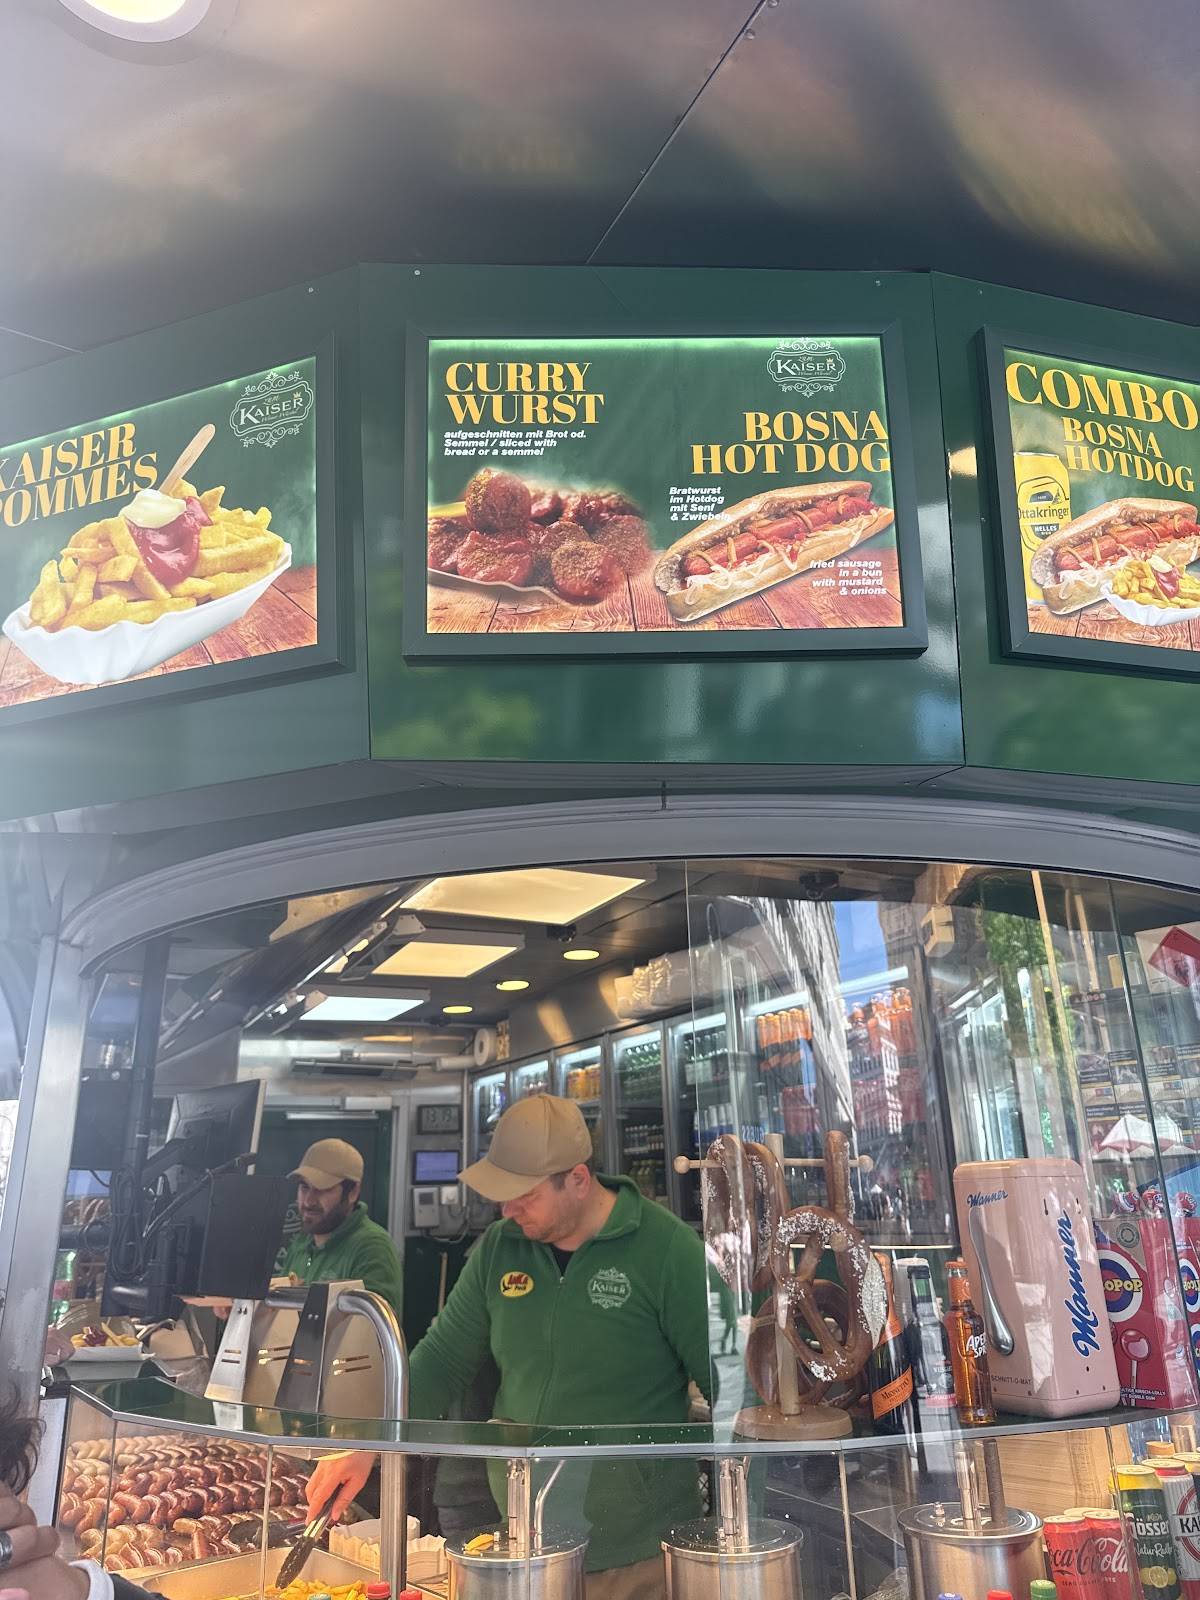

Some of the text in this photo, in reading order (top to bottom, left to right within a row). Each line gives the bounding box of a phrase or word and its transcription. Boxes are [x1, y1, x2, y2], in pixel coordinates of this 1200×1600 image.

[776, 359, 836, 375] KAISER
[445, 362, 592, 392] CURRY
[1005, 362, 1199, 431] COMBO
[240, 397, 303, 425] KAISER
[445, 394, 604, 424] WURST
[743, 410, 888, 442] BOSNA
[444, 430, 587, 439] aufgeschnitten mit Brot od.
[444, 438, 488, 447] Semmel
[499, 438, 531, 447] sliced
[534, 438, 557, 447] with
[1060, 416, 1163, 459] BOSNA
[444, 447, 475, 456] bread
[478, 448, 490, 456] or
[501, 447, 544, 456] semmel
[691, 442, 890, 474] HOT DOG
[1064, 445, 1195, 492] HOTDOG
[0, 452, 158, 527] OMMES
[669, 486, 721, 495] Bratwurst
[669, 495, 725, 504] im Hotdog
[670, 503, 716, 512] mit Senf
[670, 512, 679, 521] &
[838, 560, 882, 569] sausage
[839, 568, 849, 577] in
[861, 568, 882, 577] bun
[812, 577, 884, 587] with mustard
[839, 586, 887, 596] & onions
[966, 1189, 1009, 1208] Manner
[592, 1280, 626, 1296] KAISER
[1058, 1208, 1101, 1358] Manner
[1103, 1277, 1143, 1292] OPOP
[1179, 1516, 1200, 1534] KA
